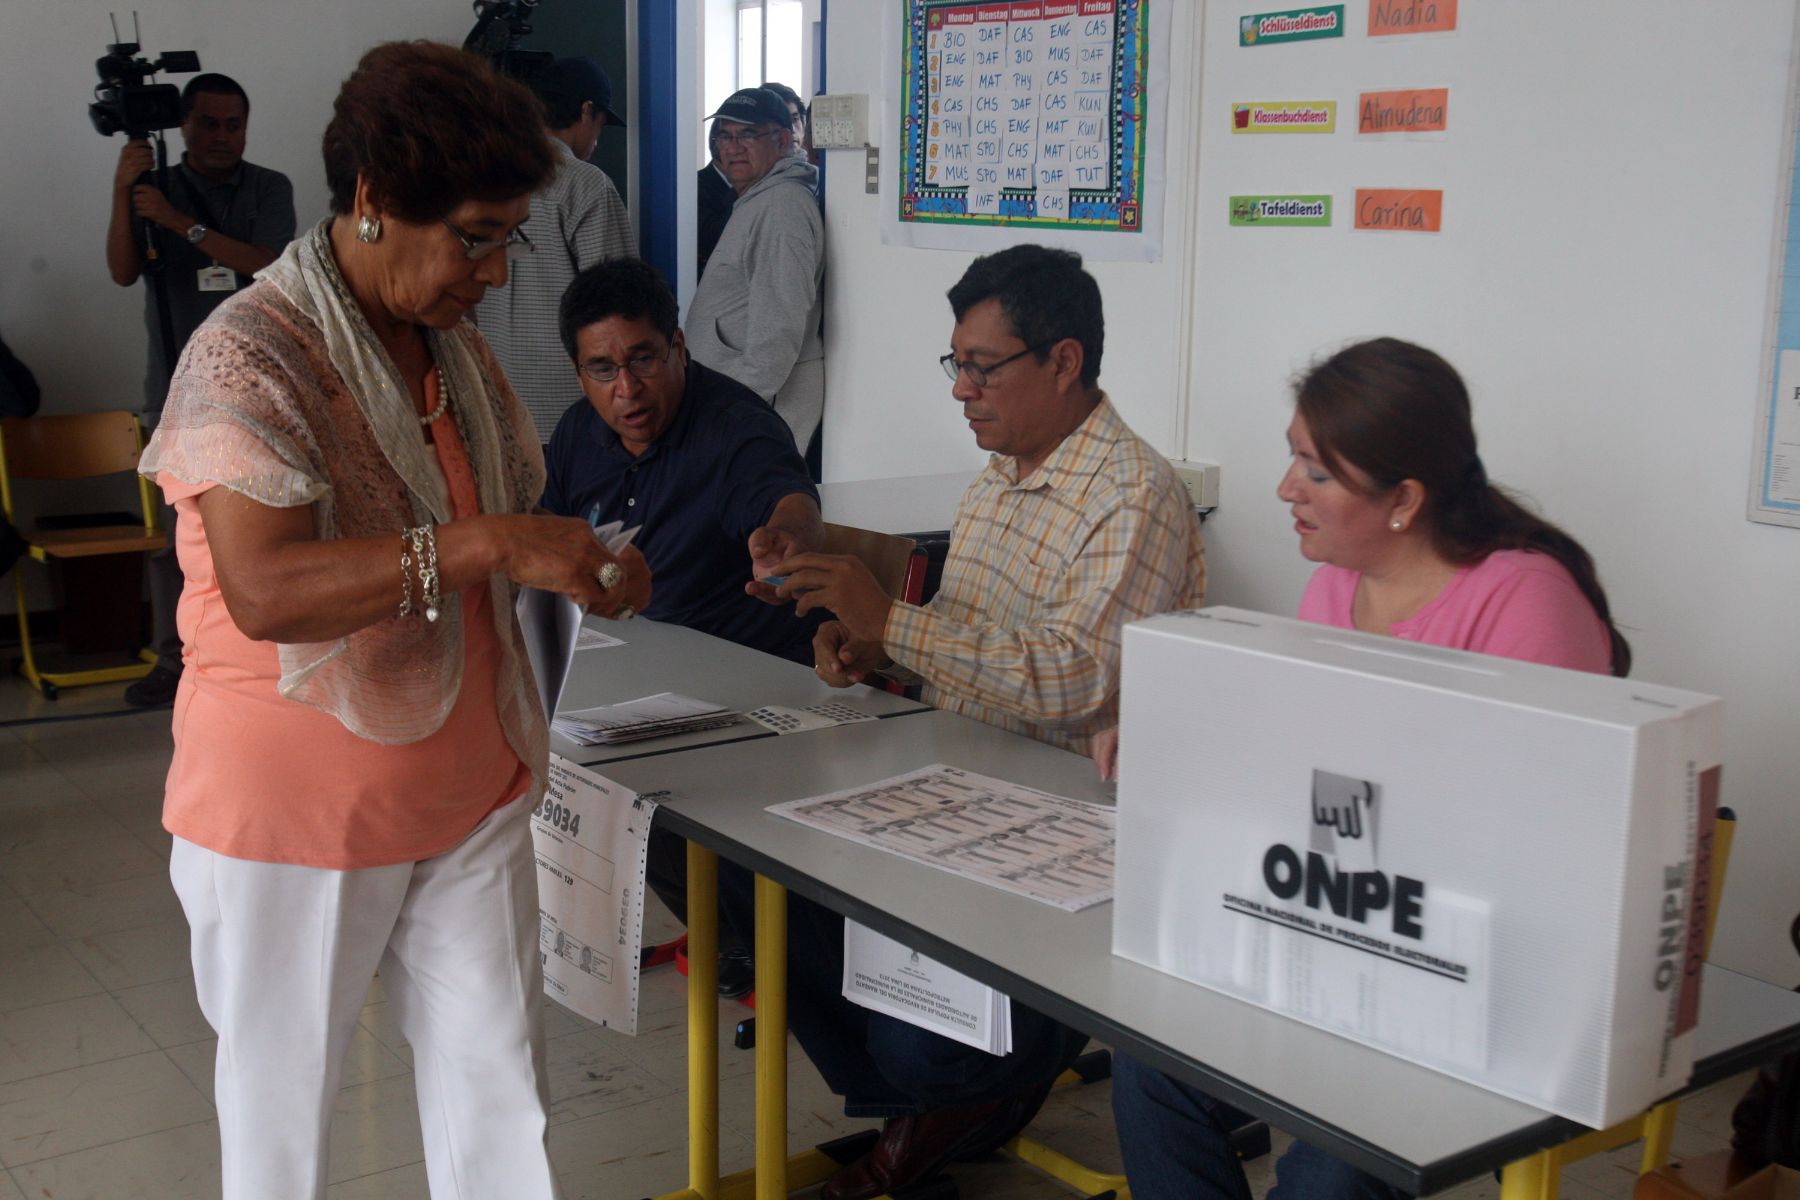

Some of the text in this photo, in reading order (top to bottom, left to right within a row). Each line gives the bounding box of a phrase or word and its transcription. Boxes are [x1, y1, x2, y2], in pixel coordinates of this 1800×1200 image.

[948, 1, 1111, 24] Montag Dienstag Mittwoch Donnerstag Freitag
[1375, 0, 1437, 28] Nadia
[978, 28, 1002, 41] DAF
[1014, 27, 1033, 42] CAS
[1050, 23, 1071, 38] ENG
[1084, 20, 1106, 36] CAS
[1260, 13, 1335, 34] Schlüsseldienst
[945, 47, 1104, 64] ENG DAF BIO MUS DAF
[945, 75, 965, 87] ENG
[979, 74, 1002, 88] MAT
[1047, 70, 1068, 86] CAS
[1081, 72, 1102, 84] DAF
[944, 94, 1101, 112] CAS CHS DAF CAS KUN
[1254, 109, 1328, 123] Klassenbuchdienst
[1360, 98, 1442, 129] Almudena
[976, 120, 997, 135] CHS
[1008, 119, 1030, 133] ENG
[1045, 120, 1068, 133] MAT
[1077, 120, 1097, 136] KUN
[944, 142, 1099, 160] MAT SPO CHS MAT CHS
[945, 166, 1103, 184] MUS SPO MAT DAF TUT
[975, 194, 1063, 210] INF CHS
[1261, 201, 1322, 216] Tafeldienst
[1360, 196, 1424, 227] Carina
[564, 875, 574, 886] 129
[1263, 843, 1424, 940] ONPE
[618, 888, 630, 945] 039034
[1653, 861, 1687, 993] ONPE
